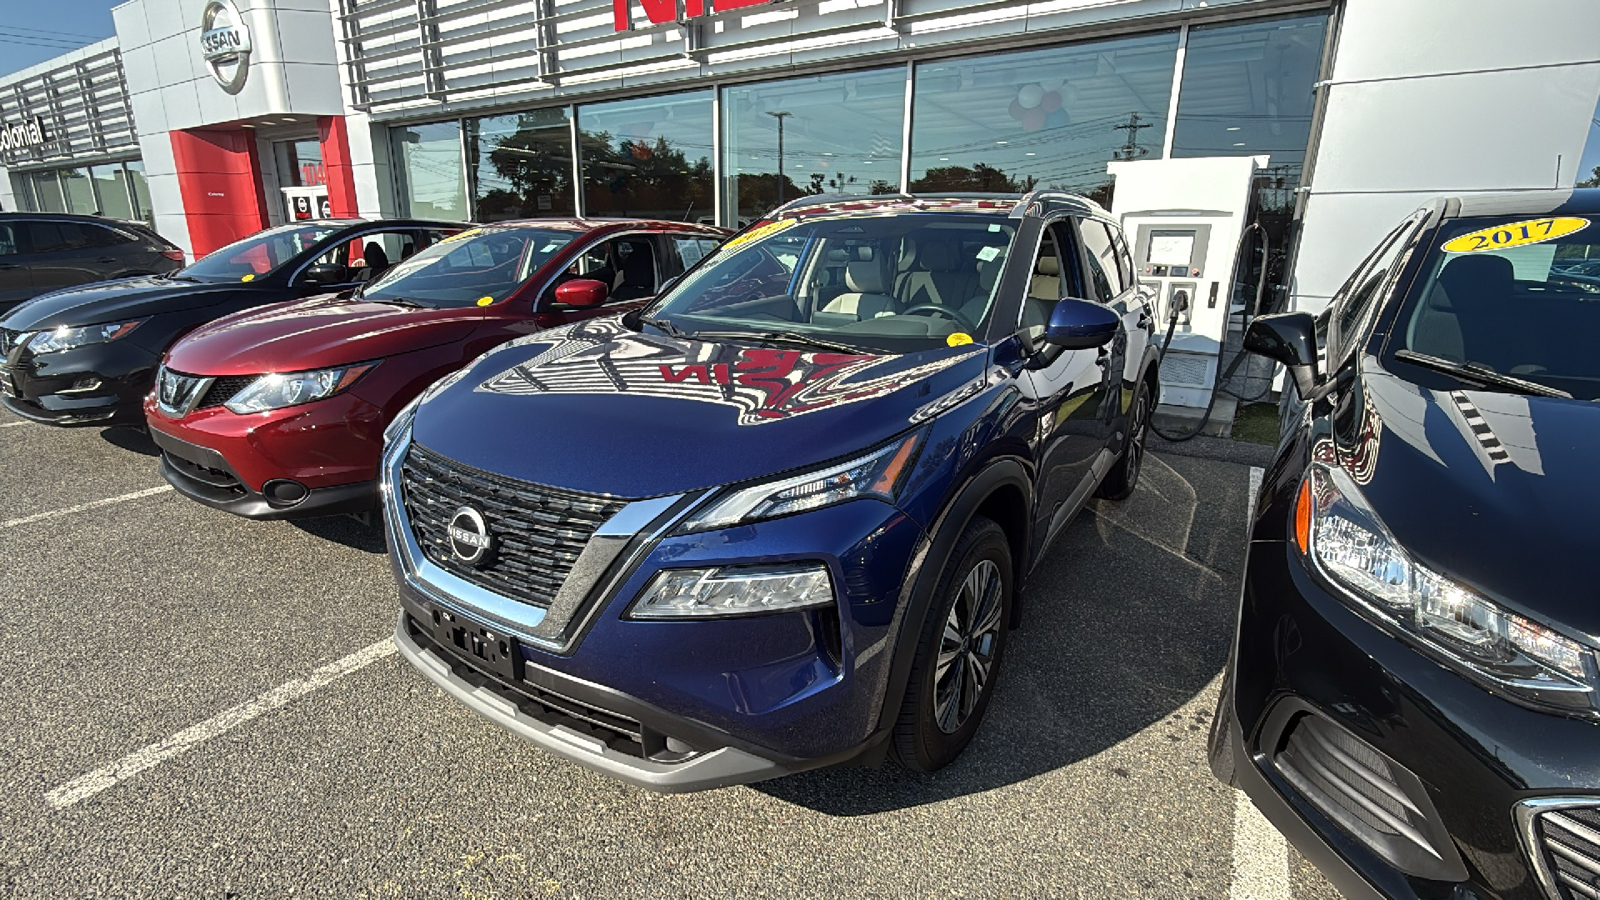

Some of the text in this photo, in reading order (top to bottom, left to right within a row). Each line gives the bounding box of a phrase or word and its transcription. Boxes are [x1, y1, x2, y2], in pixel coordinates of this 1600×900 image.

[202, 30, 241, 53] SSAN
[302, 163, 326, 186] 104
[1469, 219, 1555, 250] 2017
[448, 524, 489, 547] NISSAN
